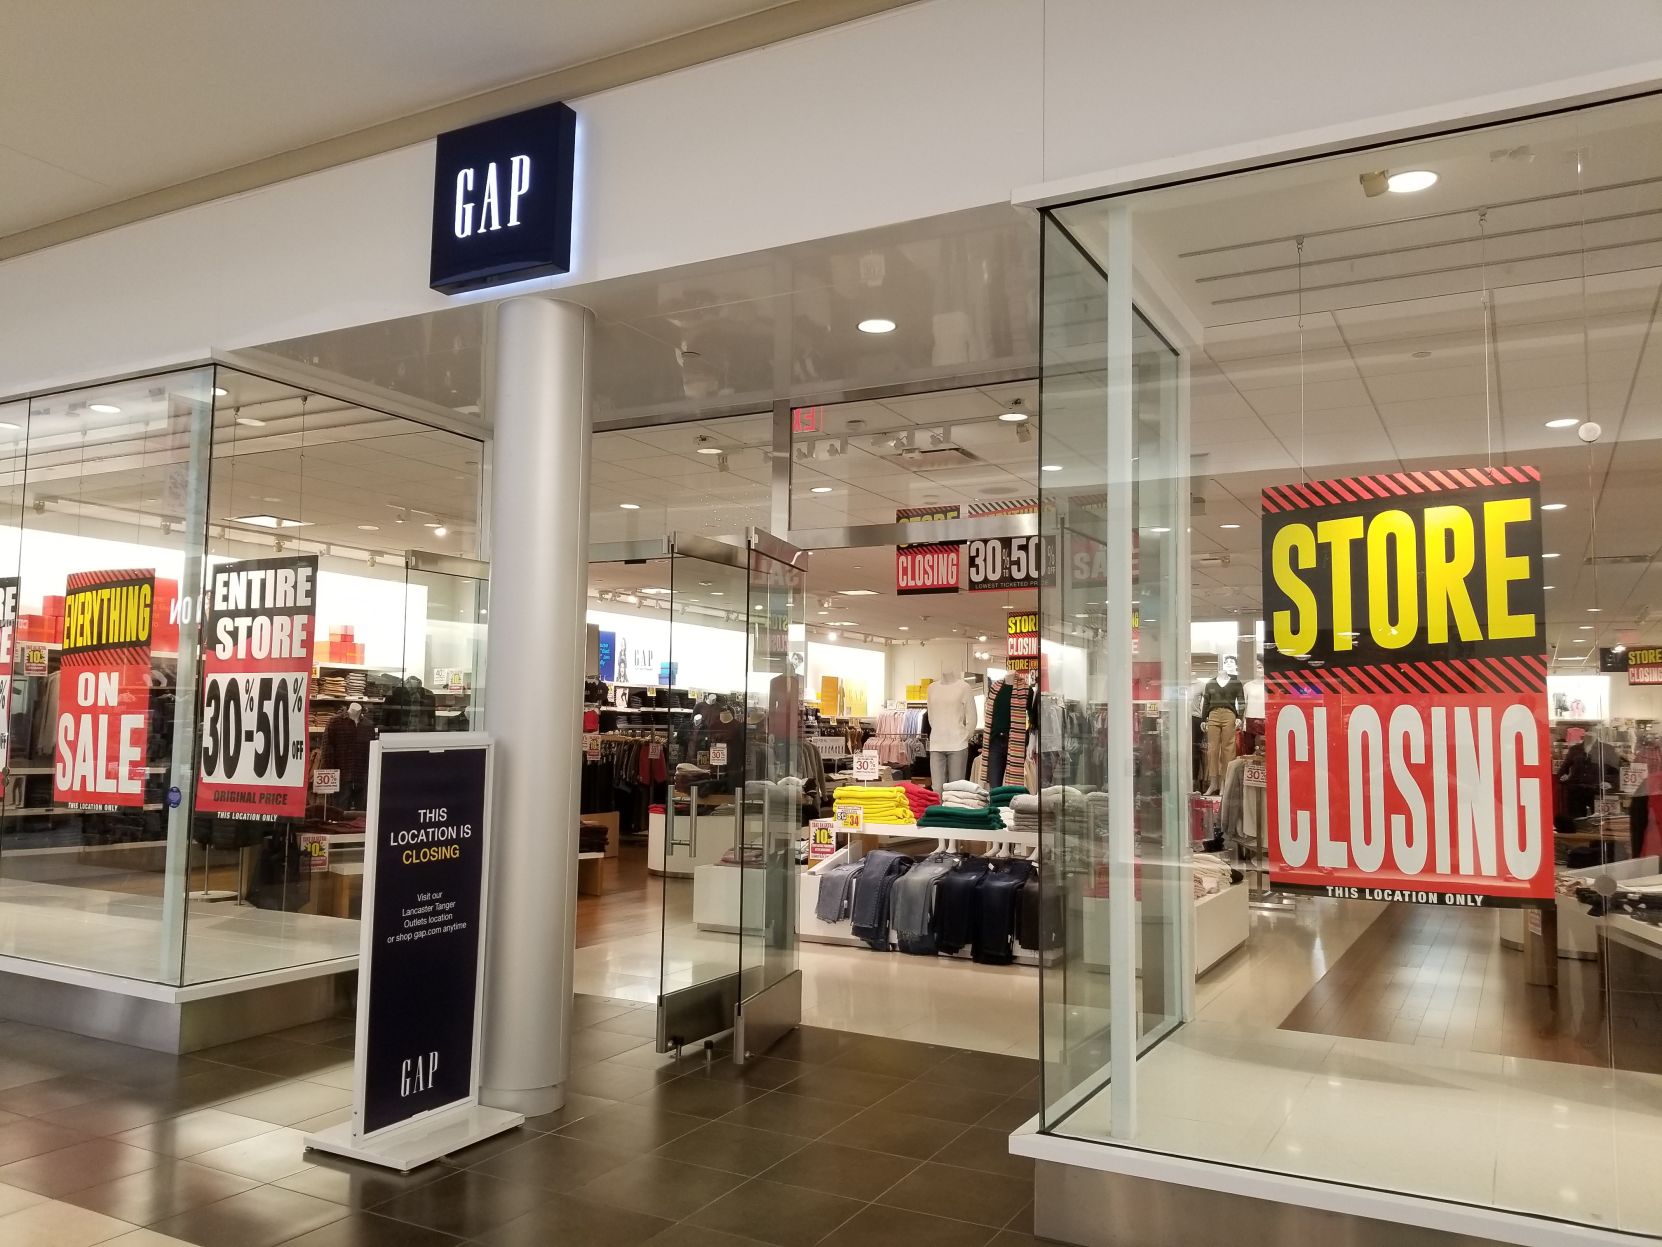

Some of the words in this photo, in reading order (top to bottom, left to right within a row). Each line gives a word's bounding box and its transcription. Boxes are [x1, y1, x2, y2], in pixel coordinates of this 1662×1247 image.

[455, 154, 531, 238] GAP
[899, 552, 957, 587] CLOSING
[1271, 497, 1537, 657] STORE
[214, 566, 312, 611] ENTIRE
[63, 583, 151, 650] EVERYTHING
[215, 614, 307, 661] STORE
[1006, 659, 1029, 671] STORE
[77, 671, 120, 707] ON
[56, 713, 145, 794] SALE
[292, 740, 304, 760] OFF
[213, 790, 257, 804] ORIGINAL
[258, 793, 288, 805] PRICE
[1275, 703, 1542, 880] CLOSING
[80, 803, 103, 811] LOCATION
[104, 804, 118, 812] ONLY
[217, 811, 231, 820] THIS
[232, 813, 260, 821] LOCATION
[418, 807, 448, 823] THIS
[390, 825, 457, 846] LOCATION
[460, 824, 472, 838] IS
[402, 844, 460, 864] CLOSING
[417, 892, 431, 902] Visit
[432, 891, 443, 899] our
[1326, 885, 1359, 899] THIS
[1365, 888, 1438, 904] LOCATION
[1445, 893, 1484, 907] ONLY
[402, 905, 434, 917] Lancaster
[435, 901, 456, 912] Tanger
[404, 917, 428, 928] Outlets
[428, 912, 453, 924] location
[396, 931, 413, 943] shop
[413, 926, 442, 941] gap.com
[442, 920, 467, 934] anytime
[400, 1051, 439, 1098] GAP
